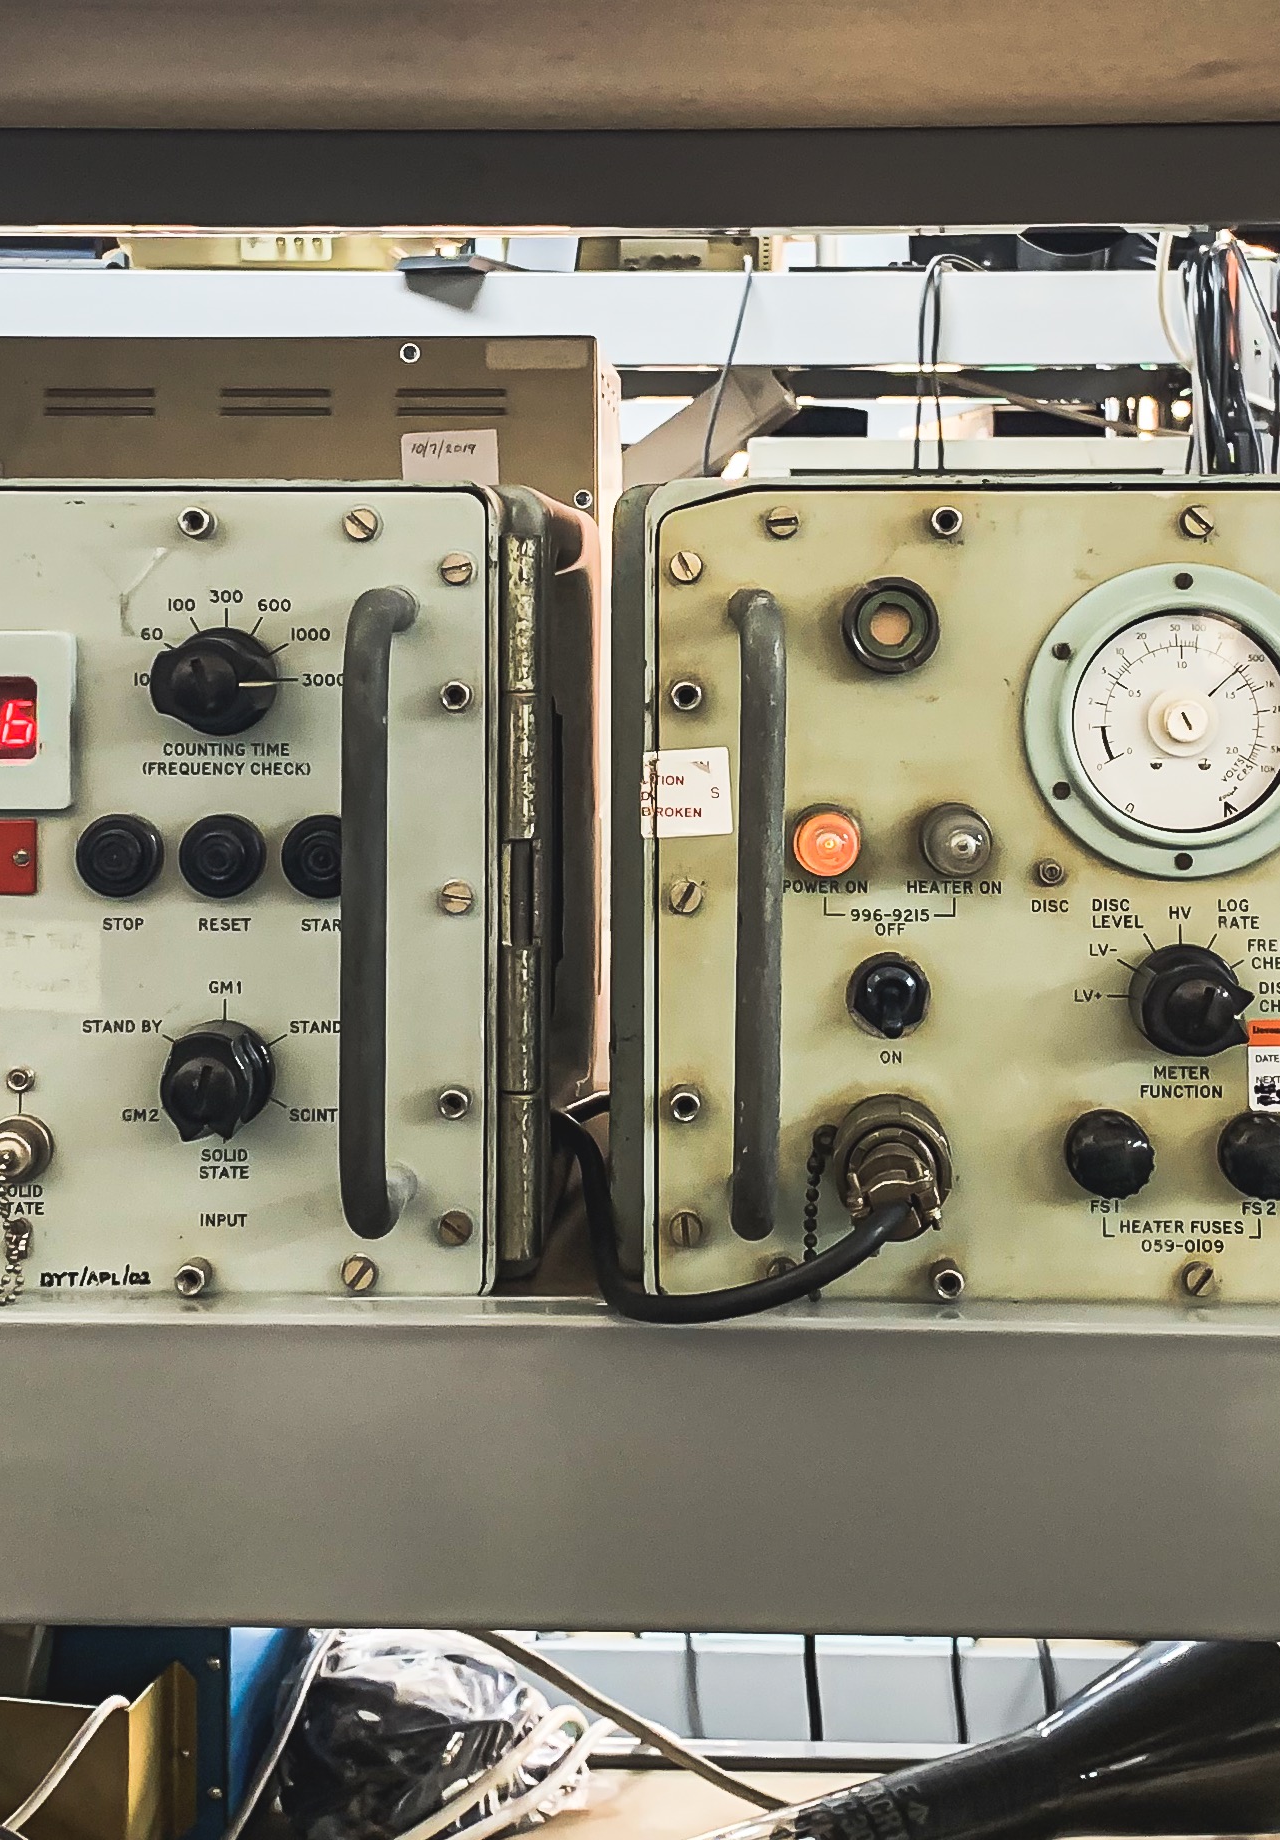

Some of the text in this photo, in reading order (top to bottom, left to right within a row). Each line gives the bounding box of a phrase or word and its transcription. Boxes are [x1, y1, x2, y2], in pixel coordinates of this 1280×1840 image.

[411, 437, 476, 459] 10/7/2019
[210, 590, 243, 603] 300
[168, 599, 195, 612] 100
[258, 599, 291, 612] 600
[141, 628, 163, 641] 60
[291, 628, 330, 641] 1000
[1170, 624, 1180, 632] 50
[1192, 624, 1206, 632] 100
[1136, 632, 1147, 640] 20
[163, 743, 289, 756] COUNTING TIME
[142, 762, 311, 776] (FREQUENCY CHECK)
[641, 807, 702, 817] BROKEN
[845, 880, 868, 893] ON
[907, 881, 1002, 894] HEATER ON
[1031, 900, 1069, 912] DISC
[1092, 899, 1130, 912] DISC
[1218, 899, 1249, 912] LOG
[851, 910, 930, 922] 996-9215
[1169, 906, 1191, 919] HV
[103, 918, 145, 931] STOP
[198, 918, 252, 931] RESET
[1092, 916, 1144, 928] LEVEL
[1218, 916, 1259, 929] RATE
[875, 924, 905, 936] OFF
[82, 1020, 163, 1034] STAND BY
[880, 1052, 902, 1064] ON
[1154, 1066, 1209, 1080] METER
[1141, 1085, 1223, 1098] FUNCTION
[289, 1109, 338, 1122] SCINT
[201, 1149, 248, 1162] SOLID
[199, 1166, 249, 1180] STATE
[200, 1213, 248, 1227] INPUT
[1120, 1221, 1244, 1234] HEATER FUSES
[1142, 1240, 1224, 1253] 059-0109
